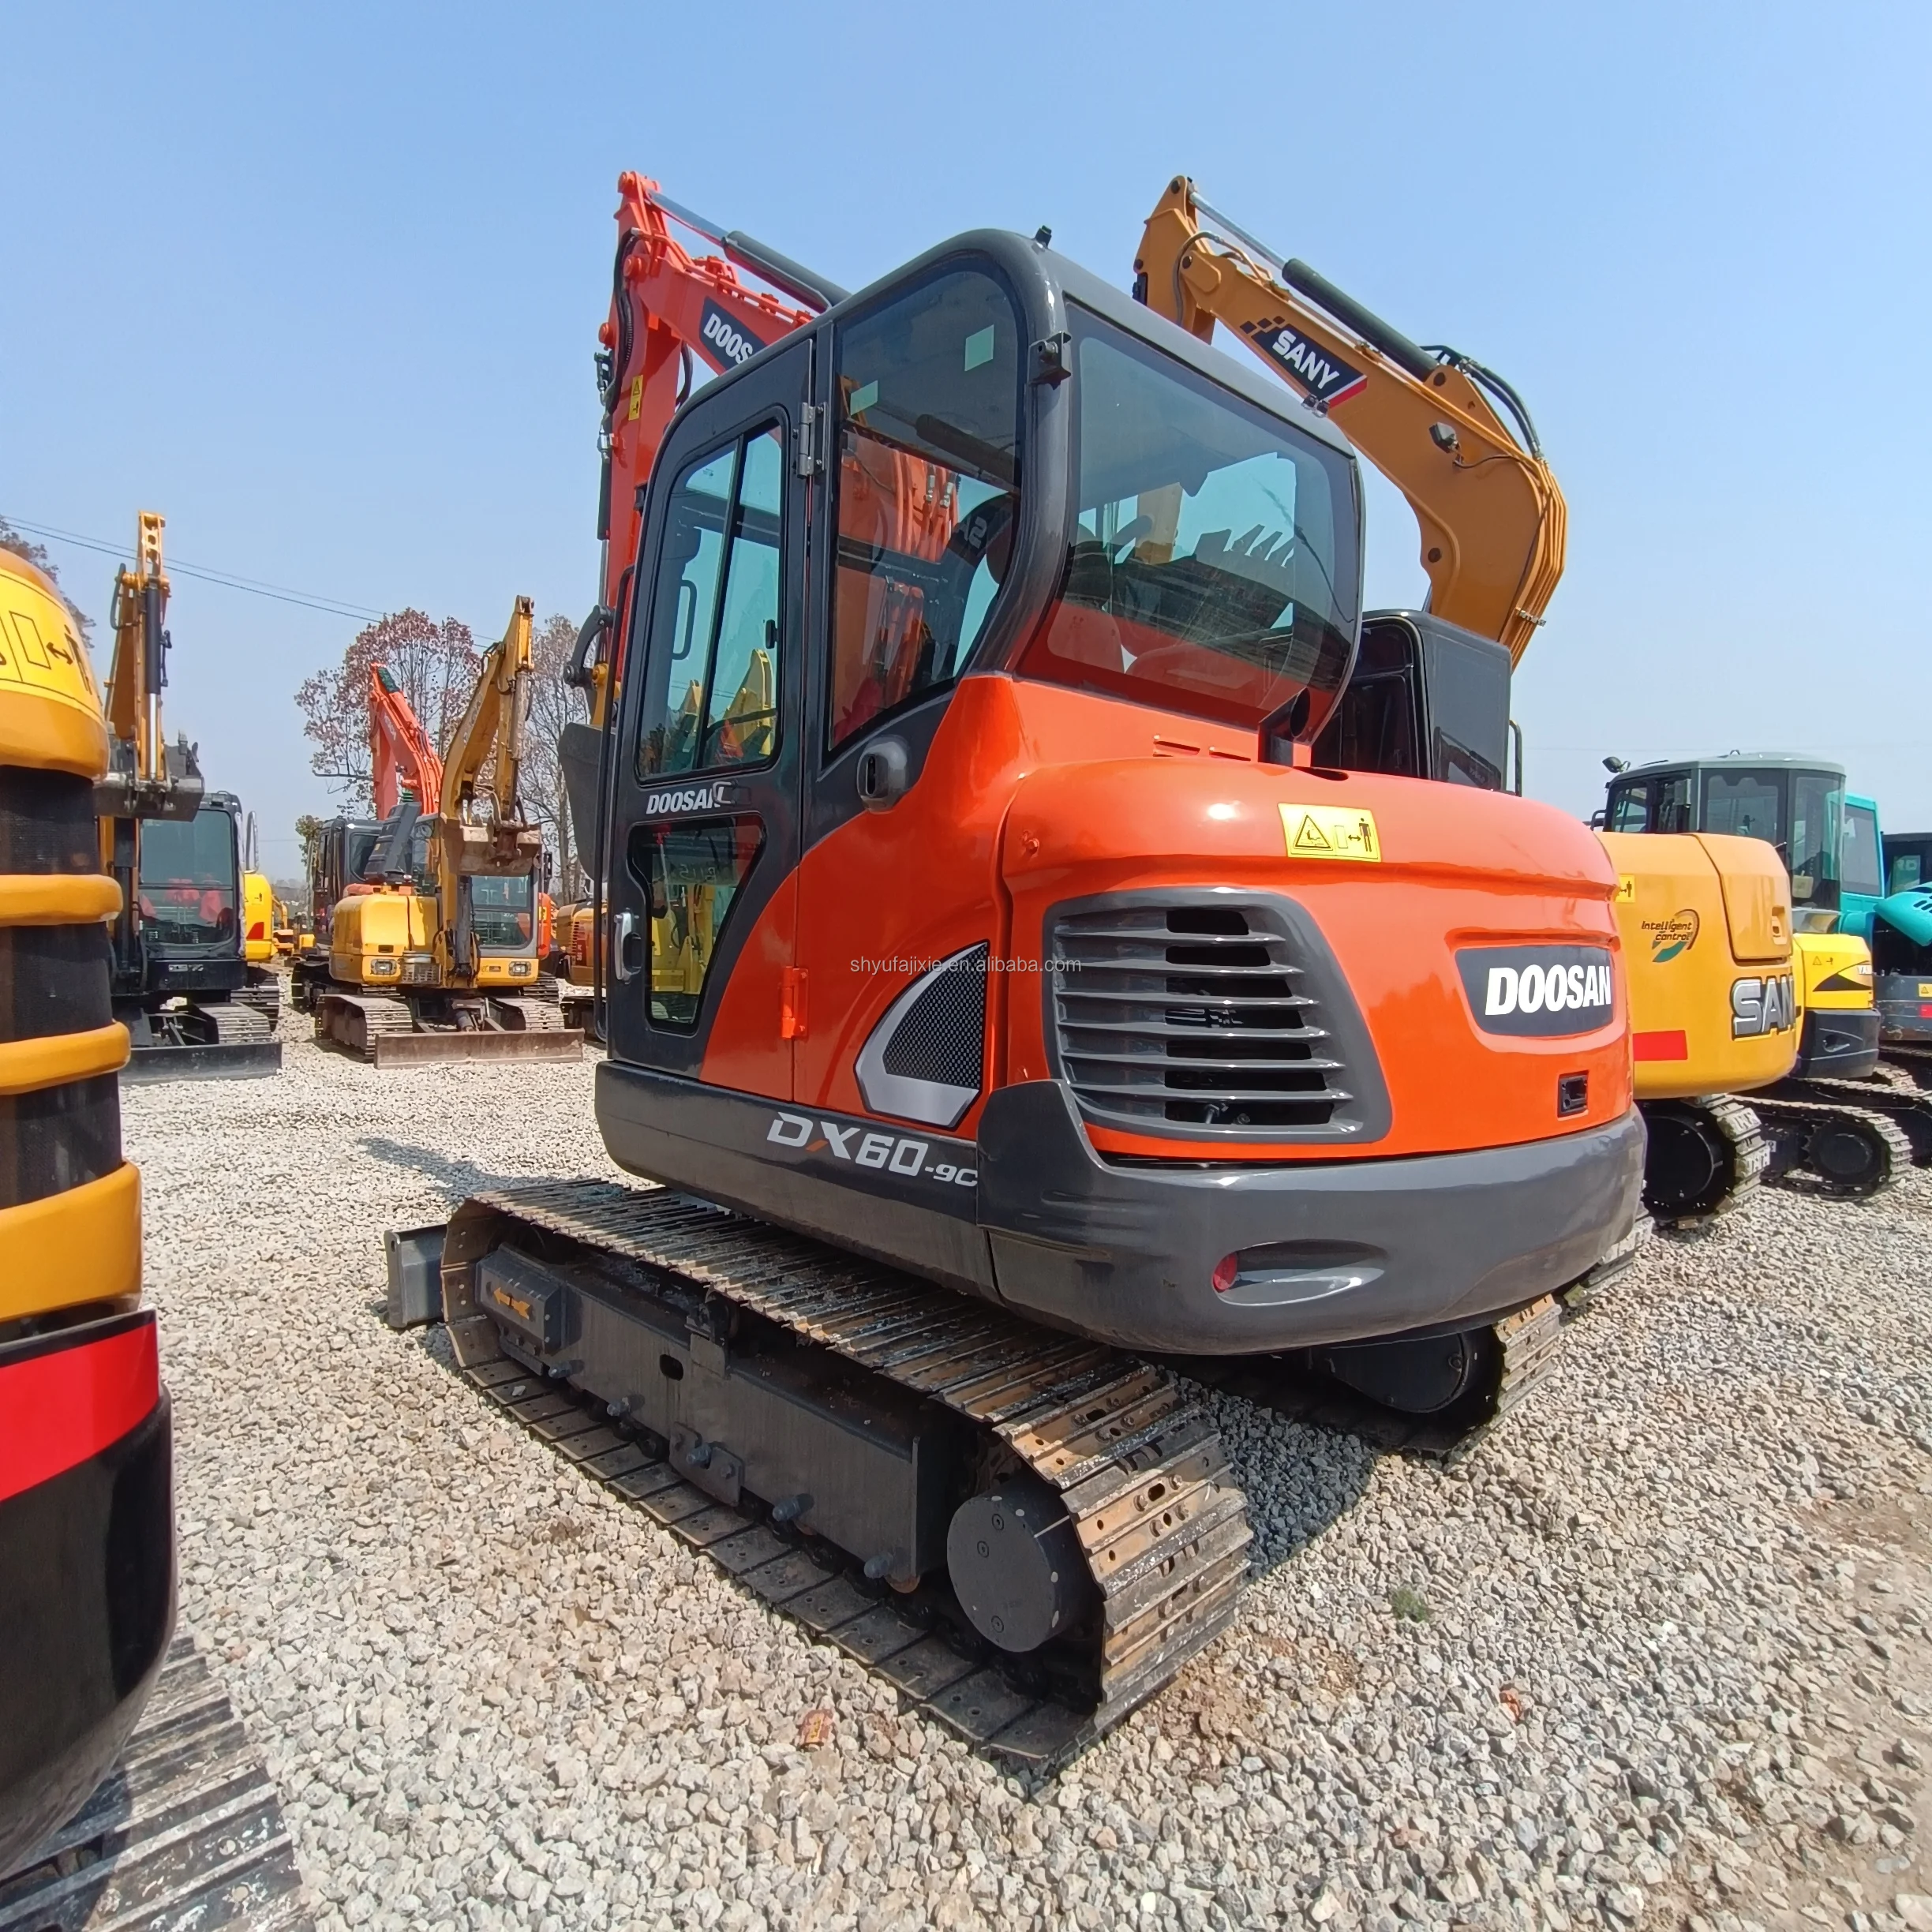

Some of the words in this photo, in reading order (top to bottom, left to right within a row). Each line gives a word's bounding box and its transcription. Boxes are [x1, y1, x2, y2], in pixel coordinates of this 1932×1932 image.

[1272, 330, 1340, 390] SANY
[1642, 918, 1692, 932] Intelligent
[1655, 931, 1692, 941] control
[1485, 964, 1612, 1016] DOOSAN
